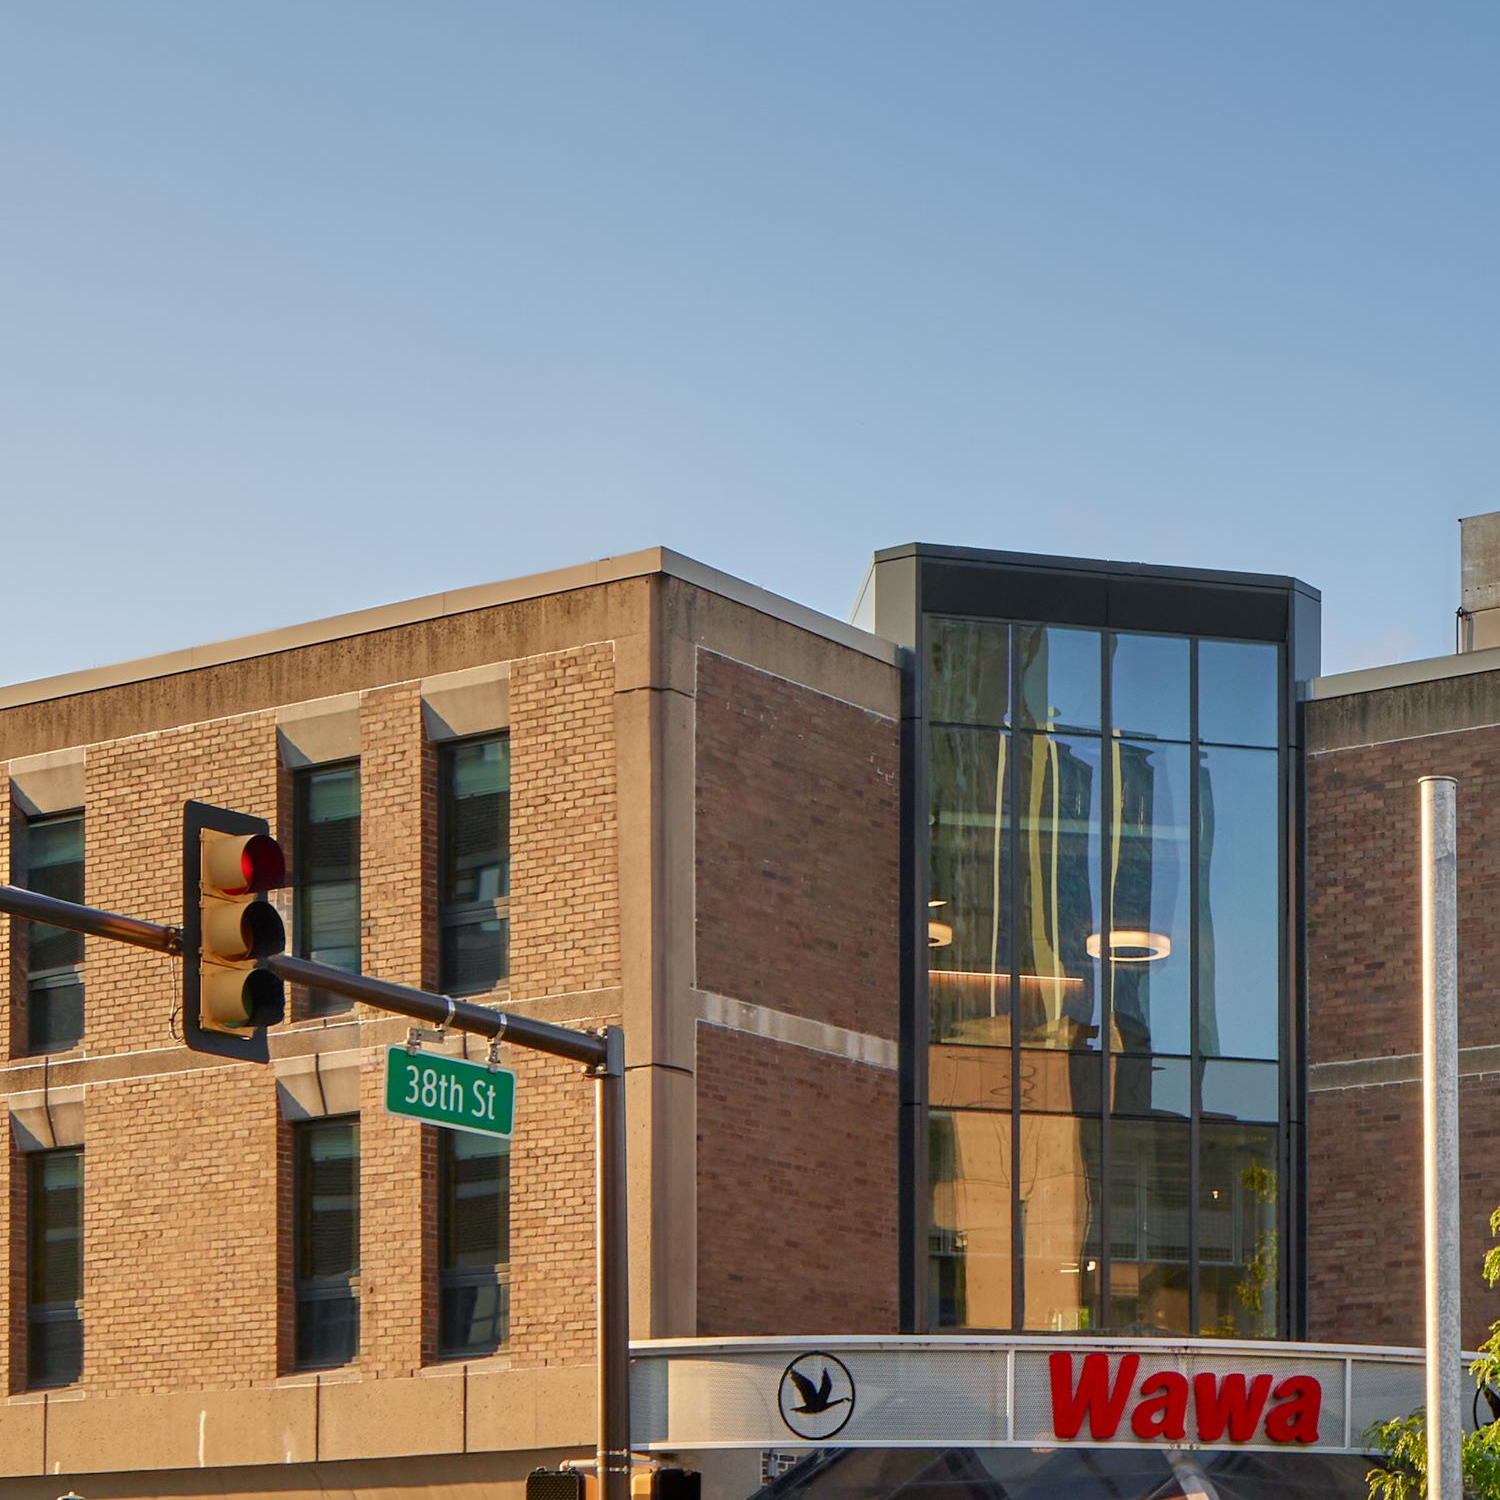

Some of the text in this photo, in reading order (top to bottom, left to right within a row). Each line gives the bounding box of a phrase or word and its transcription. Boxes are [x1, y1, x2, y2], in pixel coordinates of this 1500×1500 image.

[405, 1065, 497, 1120] 38th St
[1049, 1352, 1322, 1444] Wawa
